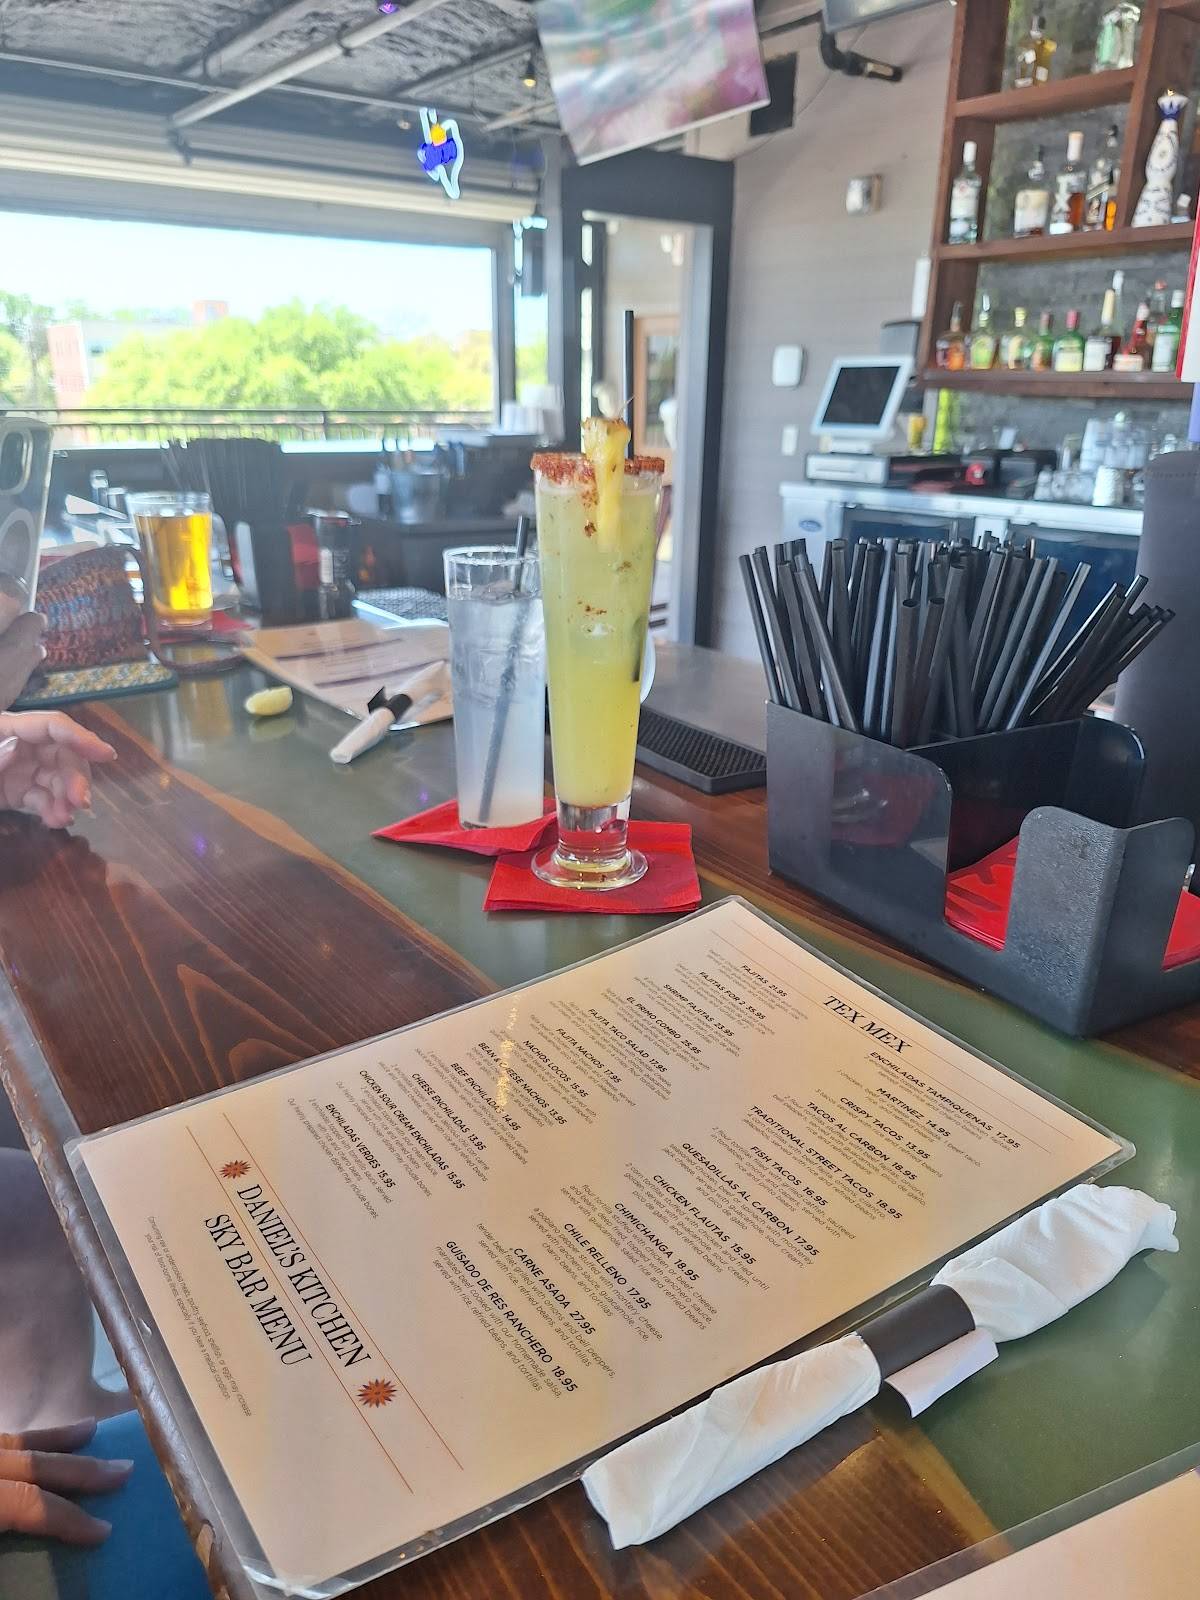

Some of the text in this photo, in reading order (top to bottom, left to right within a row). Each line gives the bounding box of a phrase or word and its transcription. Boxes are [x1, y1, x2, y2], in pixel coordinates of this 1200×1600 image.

[662, 984, 735, 1036] SHRIMP FAJITAS 23.95
[697, 971, 726, 990] FAJITAS
[723, 990, 741, 1001] FOR
[745, 1005, 766, 1019] 35.95
[740, 965, 788, 996] FAJITAS 21.95
[555, 1028, 622, 1083] FAJITA NACHOS 17.95
[588, 1008, 667, 1072] FAJITA TACO SALAD 17.95
[634, 1003, 658, 1019] PRIMO
[654, 1018, 682, 1039] COMBO
[680, 1039, 701, 1054] 25.95
[819, 994, 913, 1053] TEX MEX
[450, 1062, 521, 1130] BEEF ENCHILADAS 14.95
[477, 1042, 497, 1057] BEAN
[520, 1083, 550, 1108] NACHOS
[547, 1108, 567, 1124] 13.95
[522, 1040, 589, 1097] NACHOS LOCOS 15.95
[869, 1051, 1021, 1148] ENCHILADAS TAMPIQUENAS 17.95
[325, 1103, 395, 1188] ENCHILADAS VERDES 15.95
[358, 1069, 465, 1189] CHICKEN SOUR CREAM ENCHILADAS 15.95
[410, 1072, 486, 1150] CHEESE ENCHILADAS 13.95
[805, 1101, 917, 1180] TACOS AL CARBON 18.95
[838, 1096, 930, 1159] CRISPY TACOS 13.95
[875, 1087, 951, 1137] MARTINEZ 14.95
[681, 1142, 819, 1256] QUESADILLAS AL CARBON 17.95
[749, 1105, 903, 1219] TRADITIONAL STREET TACOS 18.95
[749, 1145, 828, 1206] FISH TACOS 16.95
[613, 1202, 699, 1281] CHIMICHANGA 18.95
[651, 1174, 756, 1264] CHICKEN FLAUTAS 15.95
[203, 1211, 312, 1369] SKY BAR MENU
[236, 1183, 371, 1369] DANIEL'S KITCHEN
[512, 1247, 595, 1335] CARNE ASADA 27.95
[562, 1222, 651, 1309] CHILE RELLENO 17.95
[445, 1240, 577, 1392] GUISADO DE RES RANCHERO 18.95
